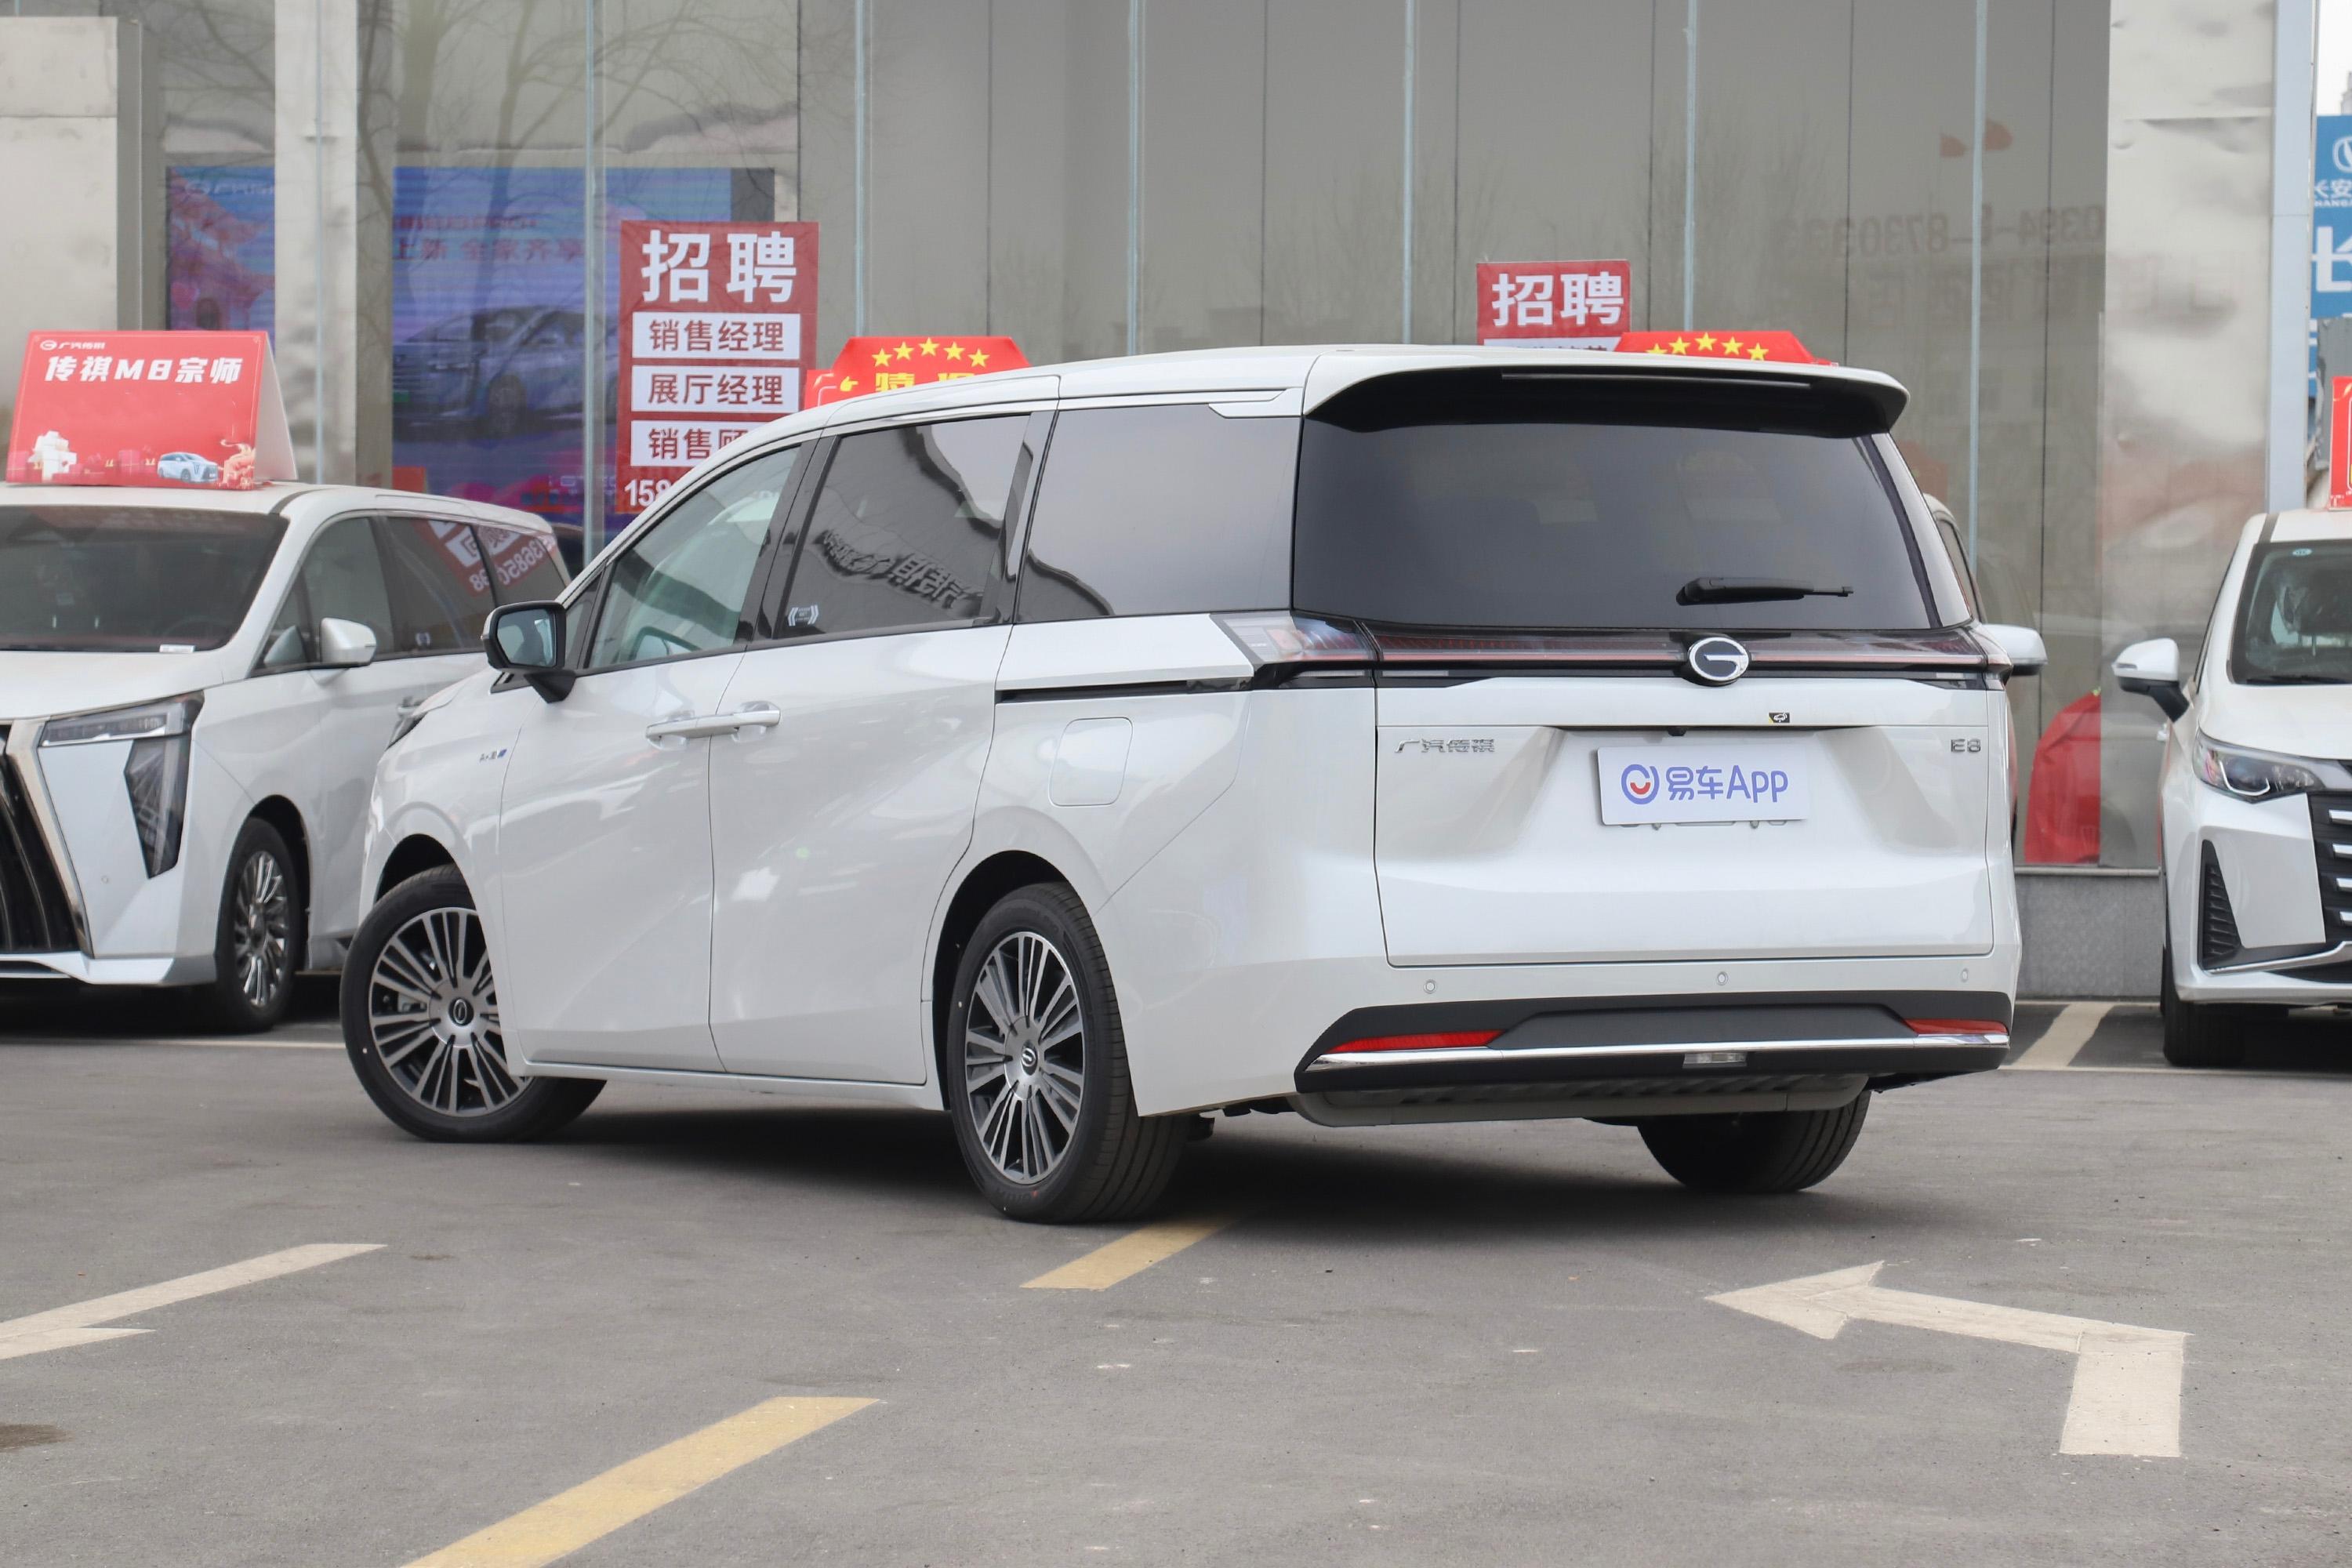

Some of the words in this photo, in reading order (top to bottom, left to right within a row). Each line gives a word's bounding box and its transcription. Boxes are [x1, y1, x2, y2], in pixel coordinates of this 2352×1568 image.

[641, 230, 797, 303] 招聘
[1491, 271, 1624, 327] 招聘
[648, 320, 785, 353] 销售经理
[45, 355, 243, 384] 传祺M8宗师
[648, 373, 784, 406] 展厅经理
[1395, 739, 1495, 753] 广汽传祺
[1665, 765, 1788, 803] 易车App
